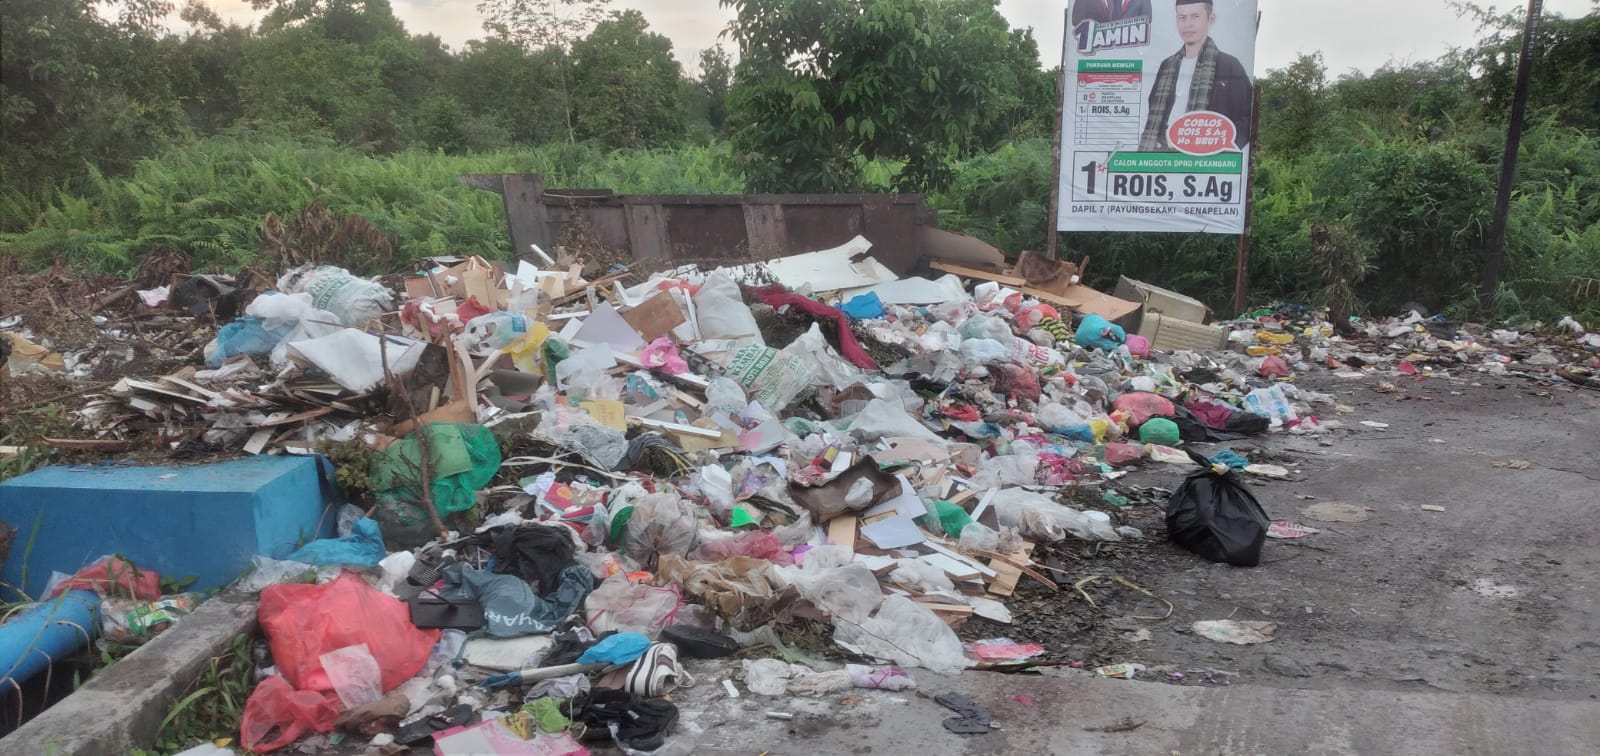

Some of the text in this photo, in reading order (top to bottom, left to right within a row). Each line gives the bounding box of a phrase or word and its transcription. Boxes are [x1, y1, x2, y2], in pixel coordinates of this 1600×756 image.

[1075, 19, 1094, 52] 1
[1093, 23, 1146, 47] AMIN
[1092, 106, 1130, 115] ROIS, S.Ag
[1184, 119, 1222, 127] COBLOS
[1138, 160, 1172, 168] ANGGOTA
[1174, 160, 1193, 168] DPRD
[1195, 161, 1237, 169] PEKANBARU
[1081, 161, 1096, 194] 1
[1113, 174, 1233, 202] ROIS, S.Ag
[1072, 205, 1097, 214] DAPIL
[1100, 206, 1105, 214] 7
[1107, 205, 1177, 215] (PAYUNGSEKAKI
[1184, 207, 1239, 217] SENAPELAN)
